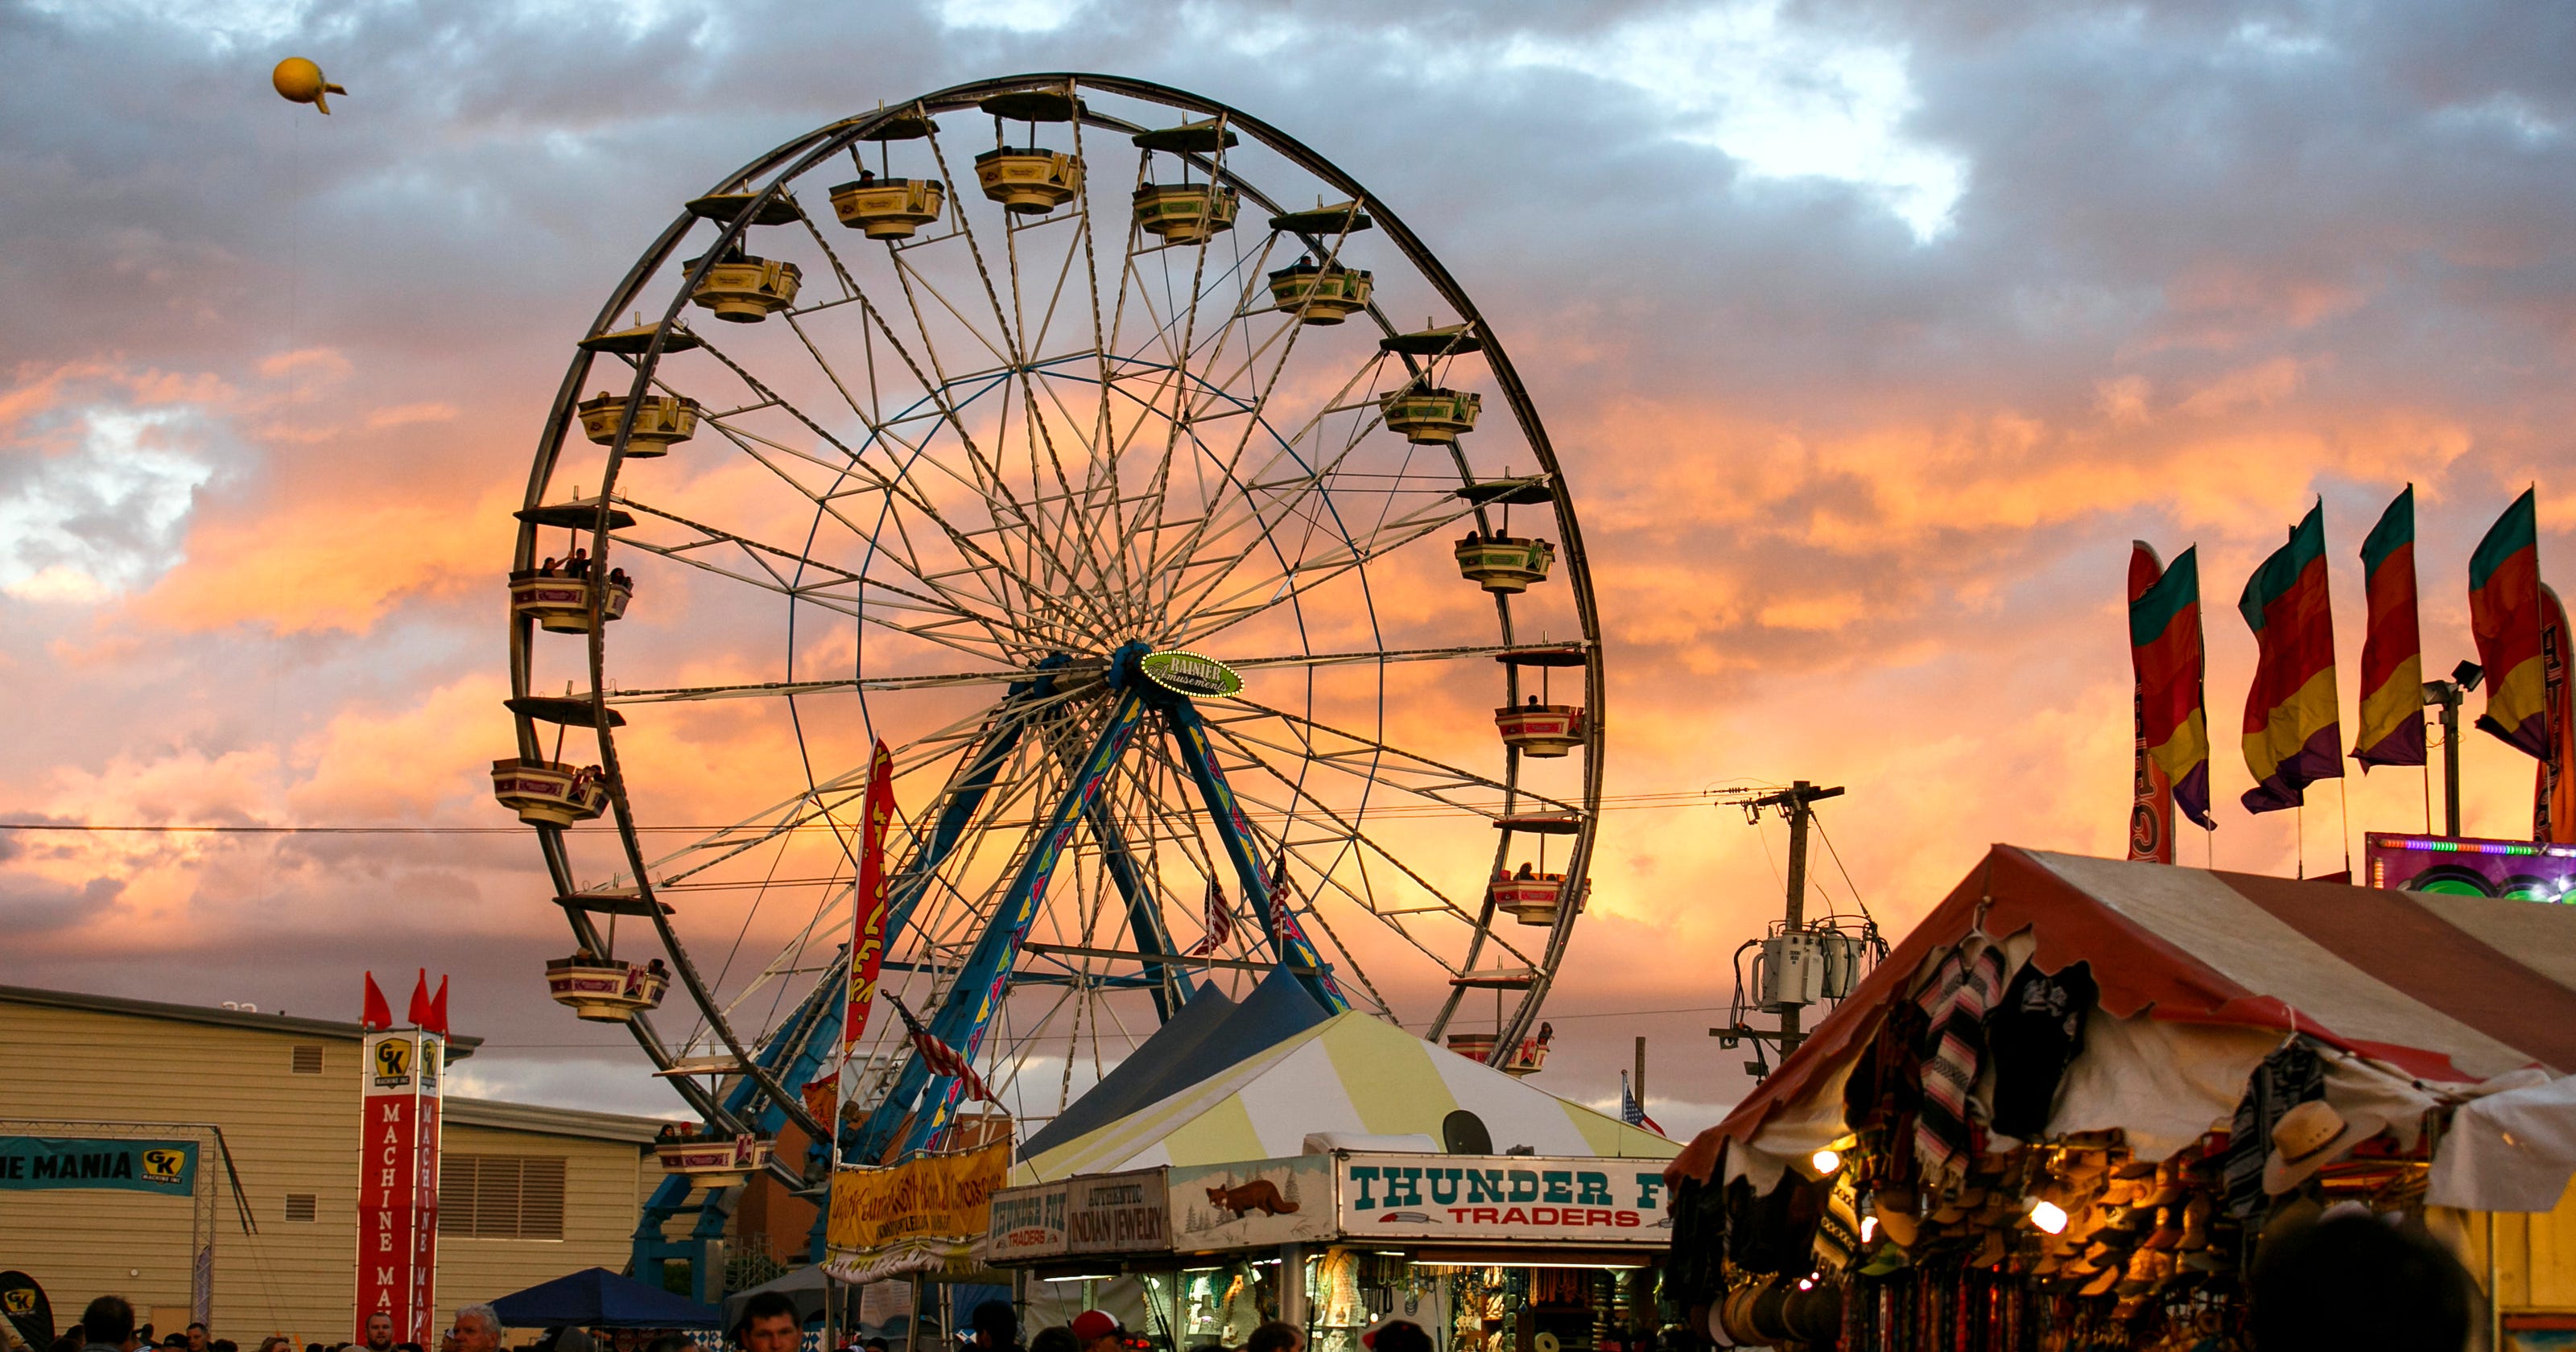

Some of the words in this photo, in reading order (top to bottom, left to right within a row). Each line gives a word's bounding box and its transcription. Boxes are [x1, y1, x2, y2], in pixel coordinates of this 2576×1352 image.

[1148, 662, 1230, 692] Amusements
[1170, 657, 1221, 681] RAINIER
[378, 1043, 403, 1074] GK
[32, 1151, 132, 1180] MANIA
[146, 1151, 176, 1174] GK
[379, 1103, 401, 1252] MACHINE
[419, 1103, 432, 1253] MACHINE
[1350, 1166, 1613, 1210] THUNDER
[1088, 1184, 1142, 1207] AUTHENTIC
[993, 1196, 1041, 1239] THUNDER
[1045, 1193, 1067, 1232] FOX
[1071, 1210, 1111, 1243] INDIAN
[1114, 1206, 1162, 1247] JEWELRY
[1447, 1207, 1640, 1227] TRADERS
[1009, 1230, 1045, 1247] TRADERS
[376, 1266, 394, 1315] MA
